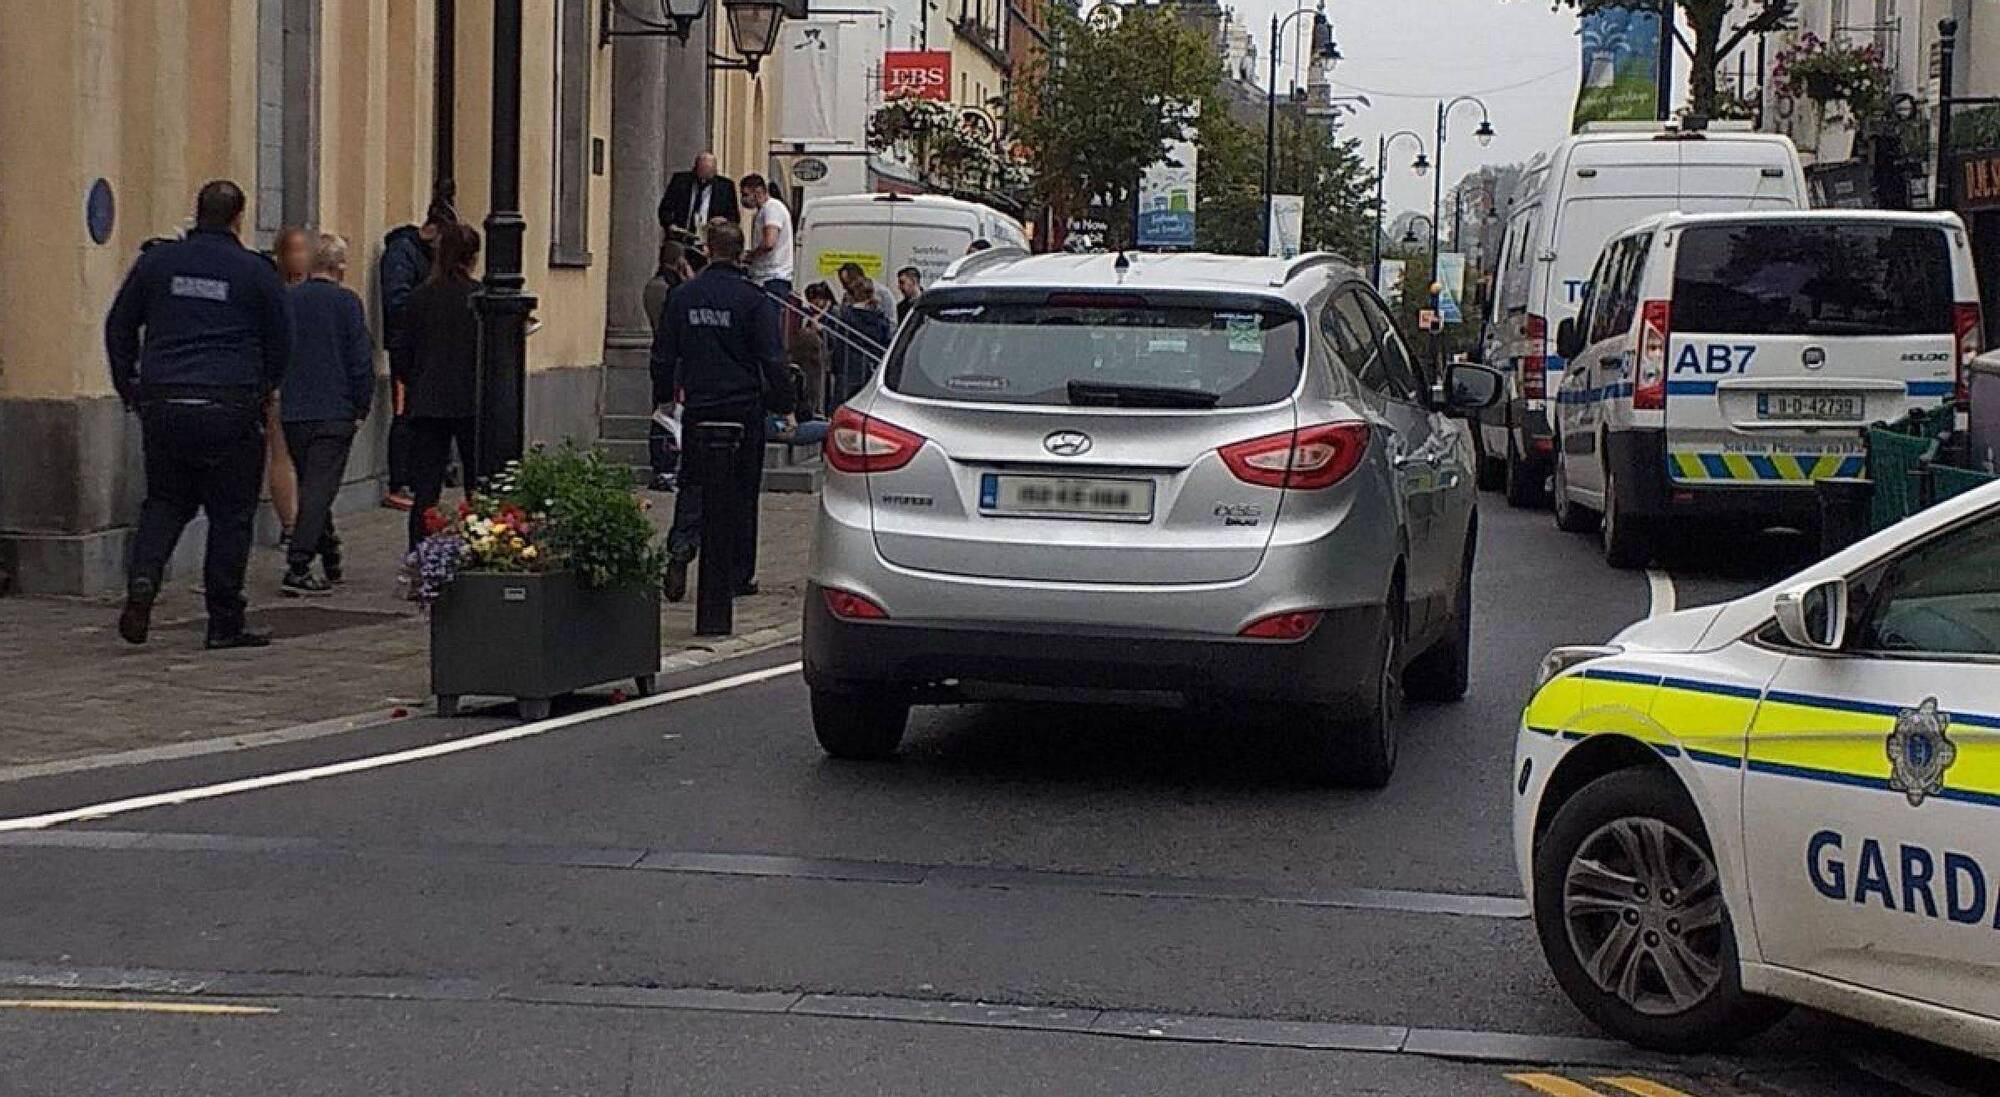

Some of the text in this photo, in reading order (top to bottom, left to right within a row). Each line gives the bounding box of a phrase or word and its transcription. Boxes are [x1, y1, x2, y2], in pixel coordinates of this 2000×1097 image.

[890, 67, 945, 85] EBS
[1673, 344, 1756, 374] AB7
[1807, 829, 2000, 930] GARD
